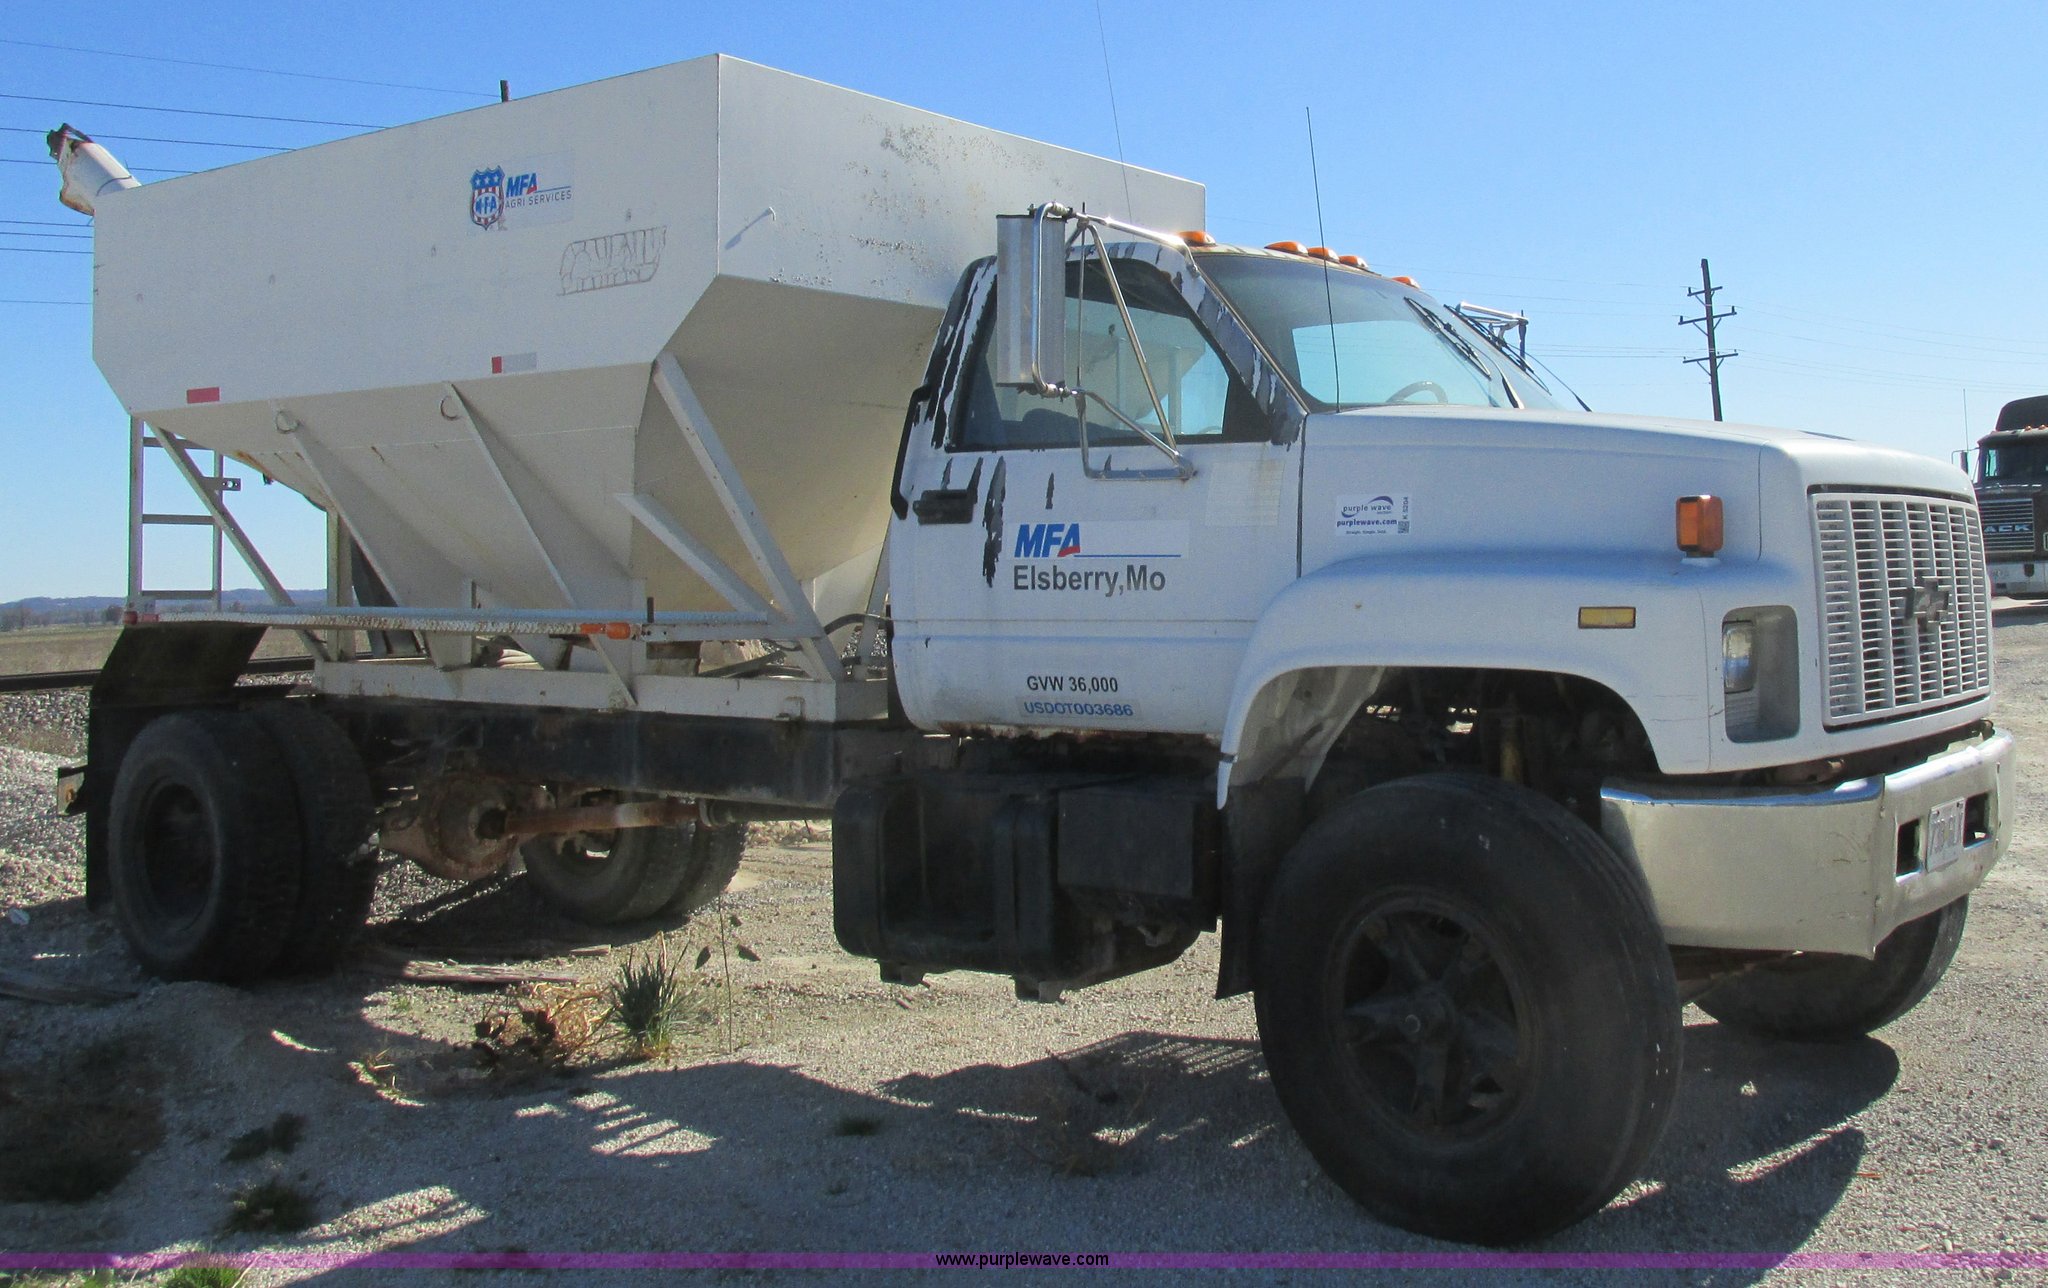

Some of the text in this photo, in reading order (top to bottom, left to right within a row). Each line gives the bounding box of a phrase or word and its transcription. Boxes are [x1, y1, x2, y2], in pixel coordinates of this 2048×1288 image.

[505, 173, 538, 198] MFA
[505, 190, 573, 209] AGRI SERVICES
[1343, 504, 1369, 513] purple
[1336, 519, 1398, 528] purplewave.com
[1984, 524, 2031, 533] ACK
[1014, 523, 1081, 558] MFA
[1013, 564, 1166, 597] Elsberry,Mo
[1026, 675, 1119, 695] GVW 36,000
[1024, 702, 1134, 717] USDOT003686
